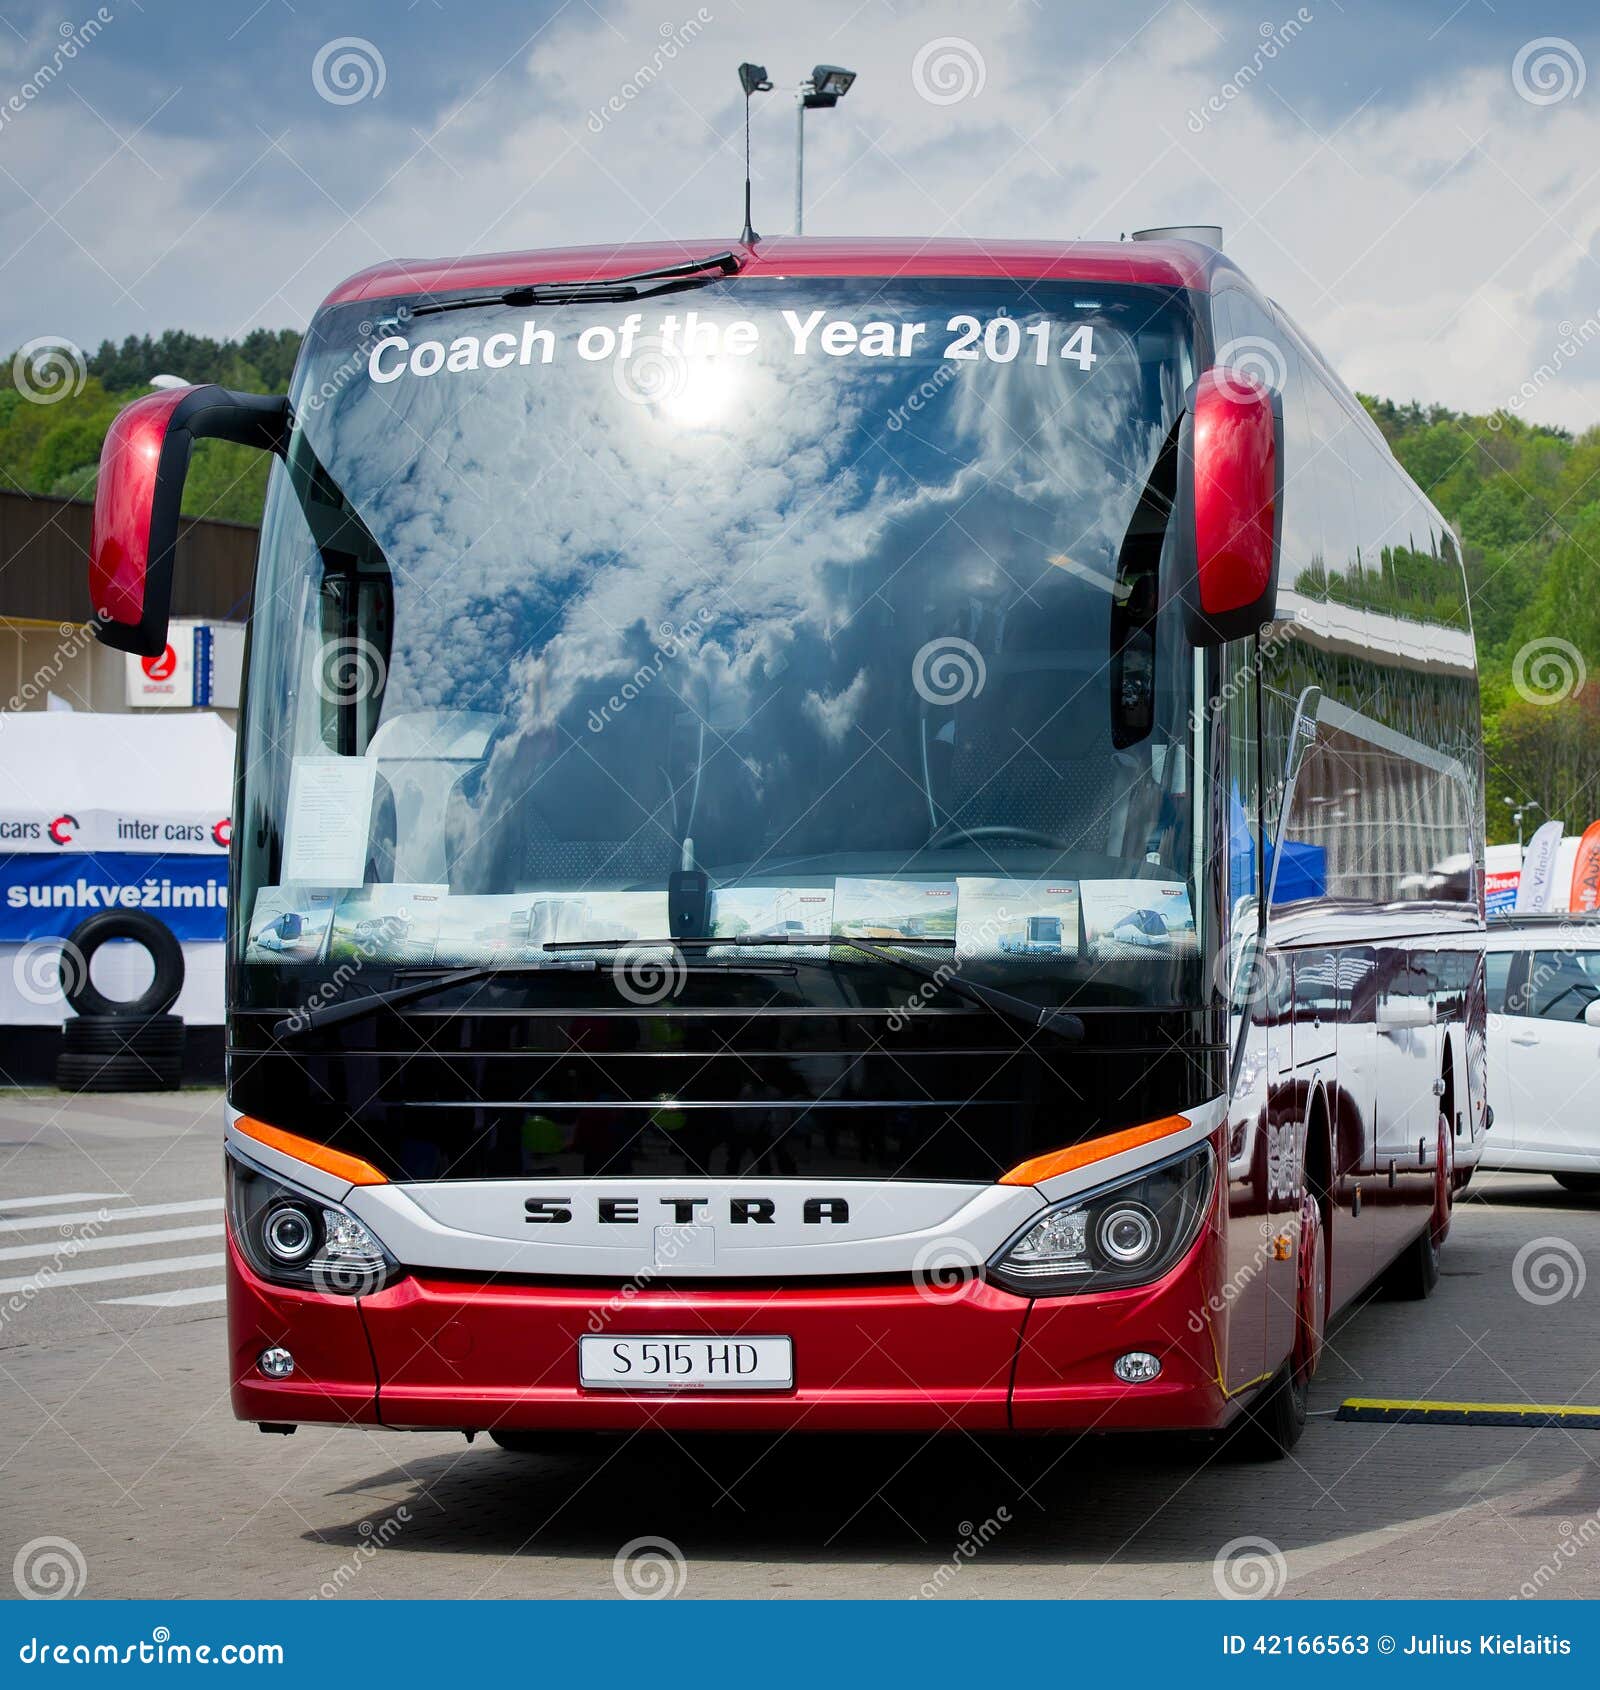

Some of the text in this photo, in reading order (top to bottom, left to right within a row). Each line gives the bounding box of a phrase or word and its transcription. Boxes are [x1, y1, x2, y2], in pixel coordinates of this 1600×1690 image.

[368, 310, 1097, 384] Coach of the Year 2014
[0, 822, 41, 839] cars
[118, 818, 205, 841] inter cars
[1533, 840, 1549, 886] Vilnius
[525, 1197, 849, 1224] SETRA
[613, 1343, 758, 1374] S 515 HD
